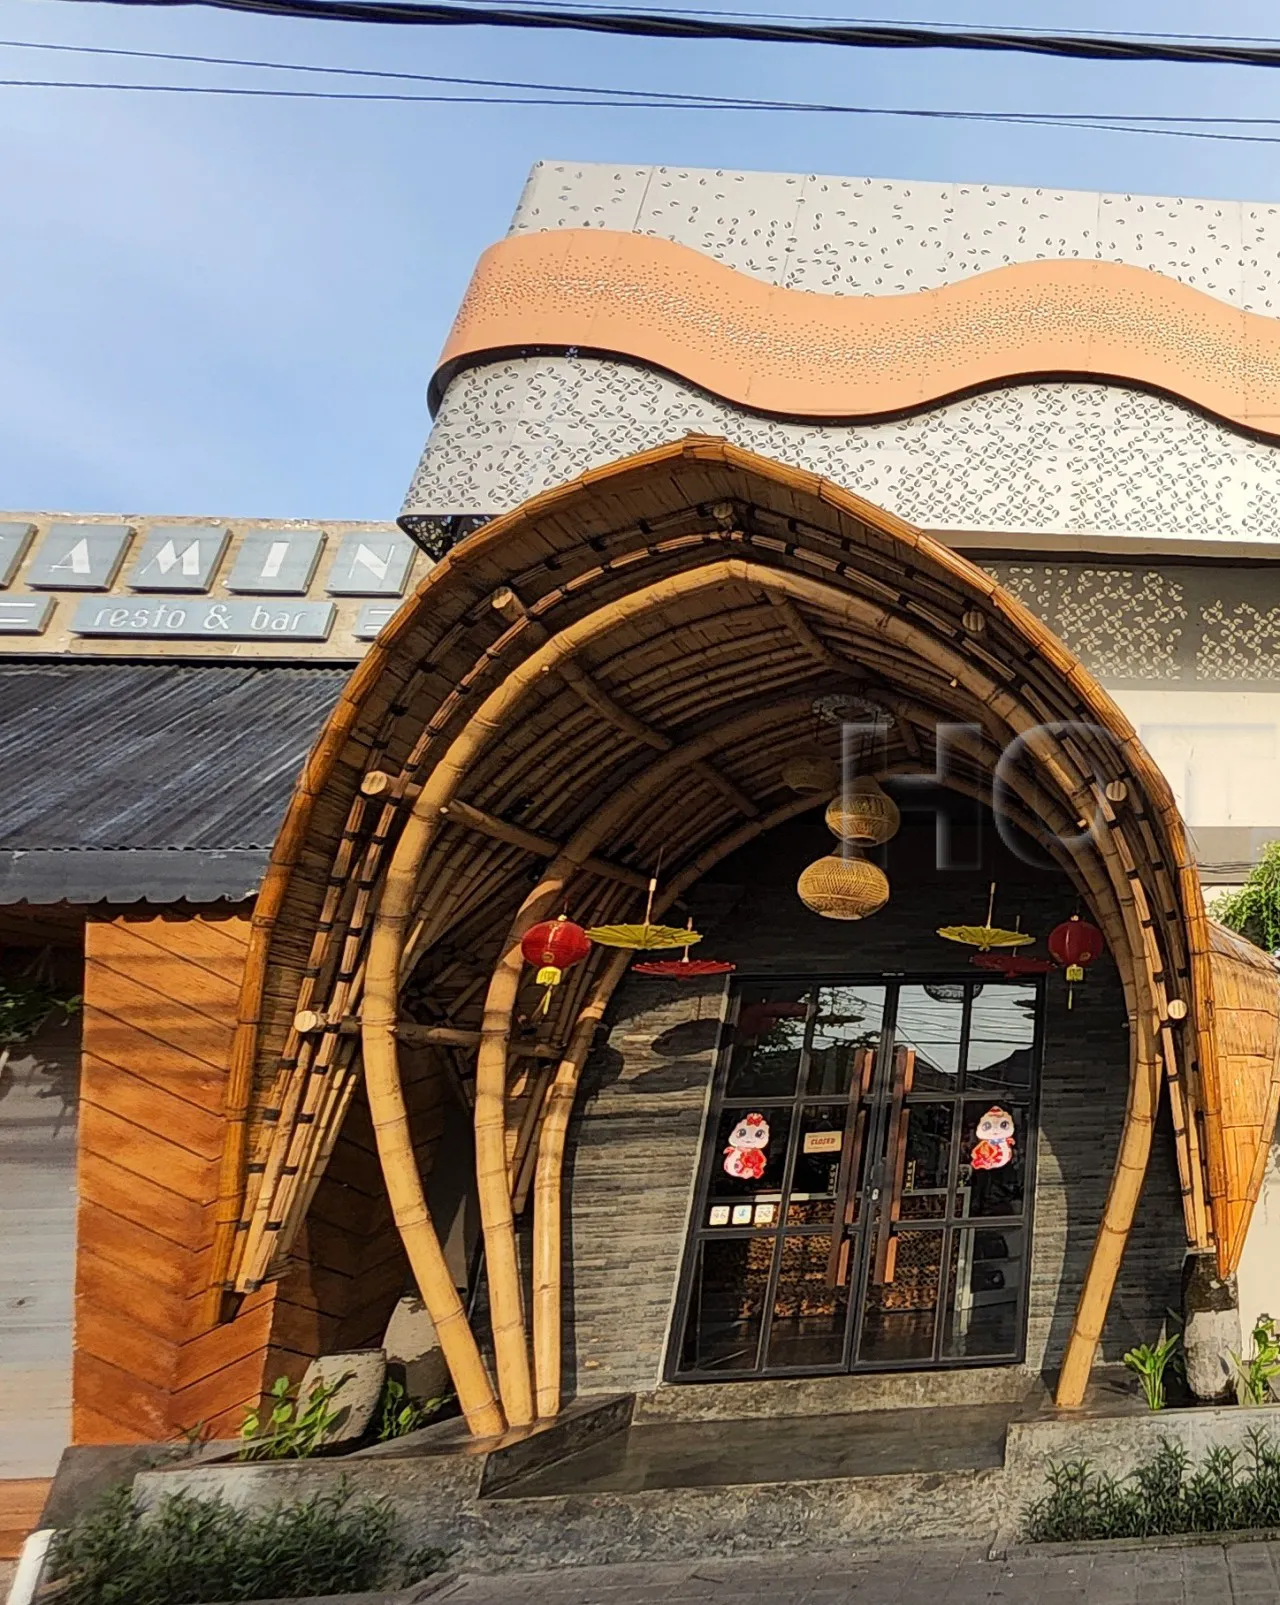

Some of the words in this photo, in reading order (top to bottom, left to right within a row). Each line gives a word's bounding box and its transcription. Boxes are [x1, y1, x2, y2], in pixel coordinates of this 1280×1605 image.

[0, 537, 396, 580] AMIN
[93, 603, 187, 630] resto
[203, 603, 233, 631] &
[250, 605, 307, 632] bar
